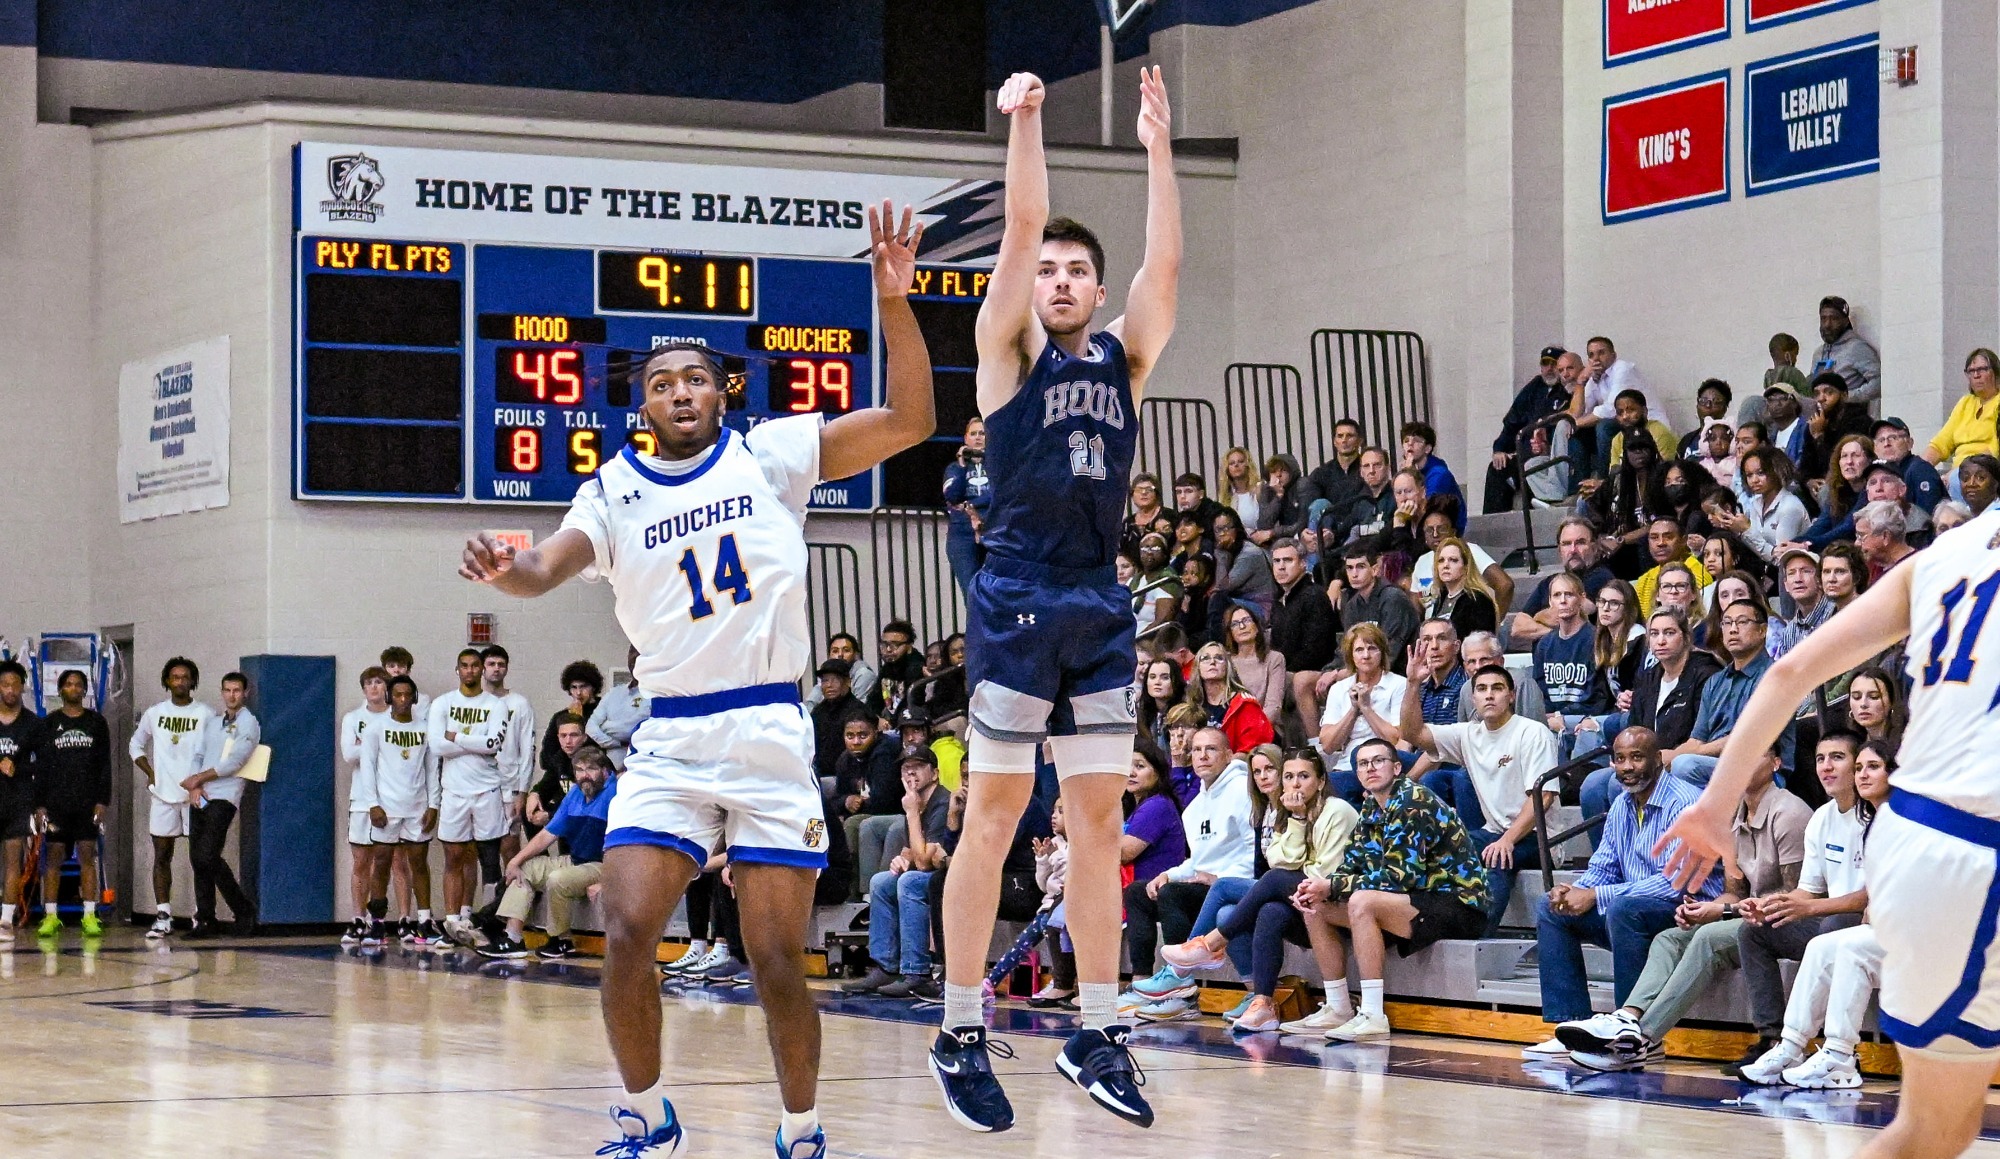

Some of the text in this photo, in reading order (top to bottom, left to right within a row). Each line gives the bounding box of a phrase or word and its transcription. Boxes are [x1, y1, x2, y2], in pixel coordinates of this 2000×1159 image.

[1780, 77, 1848, 121] LEBANON
[1638, 128, 1691, 169] KING'S
[1787, 114, 1842, 152] VALLEY
[330, 210, 375, 222] BLAZERS
[415, 178, 864, 230] HOME OF THE BLAZERS
[317, 241, 451, 273] PLY FL PTS
[638, 256, 750, 310] 9:11
[942, 271, 967, 296] FL
[514, 315, 568, 342] HOOD
[764, 326, 852, 353] GOUCHER
[162, 373, 193, 398] BLAZERS
[515, 351, 581, 403] 45
[790, 360, 849, 411] 39
[494, 408, 546, 427] FOULS
[563, 411, 606, 429] T.O.L.
[1043, 380, 1125, 431] HOOD
[512, 429, 538, 471] 8
[572, 431, 597, 474] 5
[1068, 430, 1106, 481] 21
[493, 480, 530, 497] WON
[812, 488, 848, 506] WON
[644, 494, 753, 550] GOUCHER
[676, 530, 755, 623] 14
[1922, 568, 2000, 687] 11
[1543, 662, 1587, 686] HOOD
[157, 716, 198, 733] FAMILY
[450, 706, 490, 724] FAMILY
[385, 729, 425, 748] FAMILY
